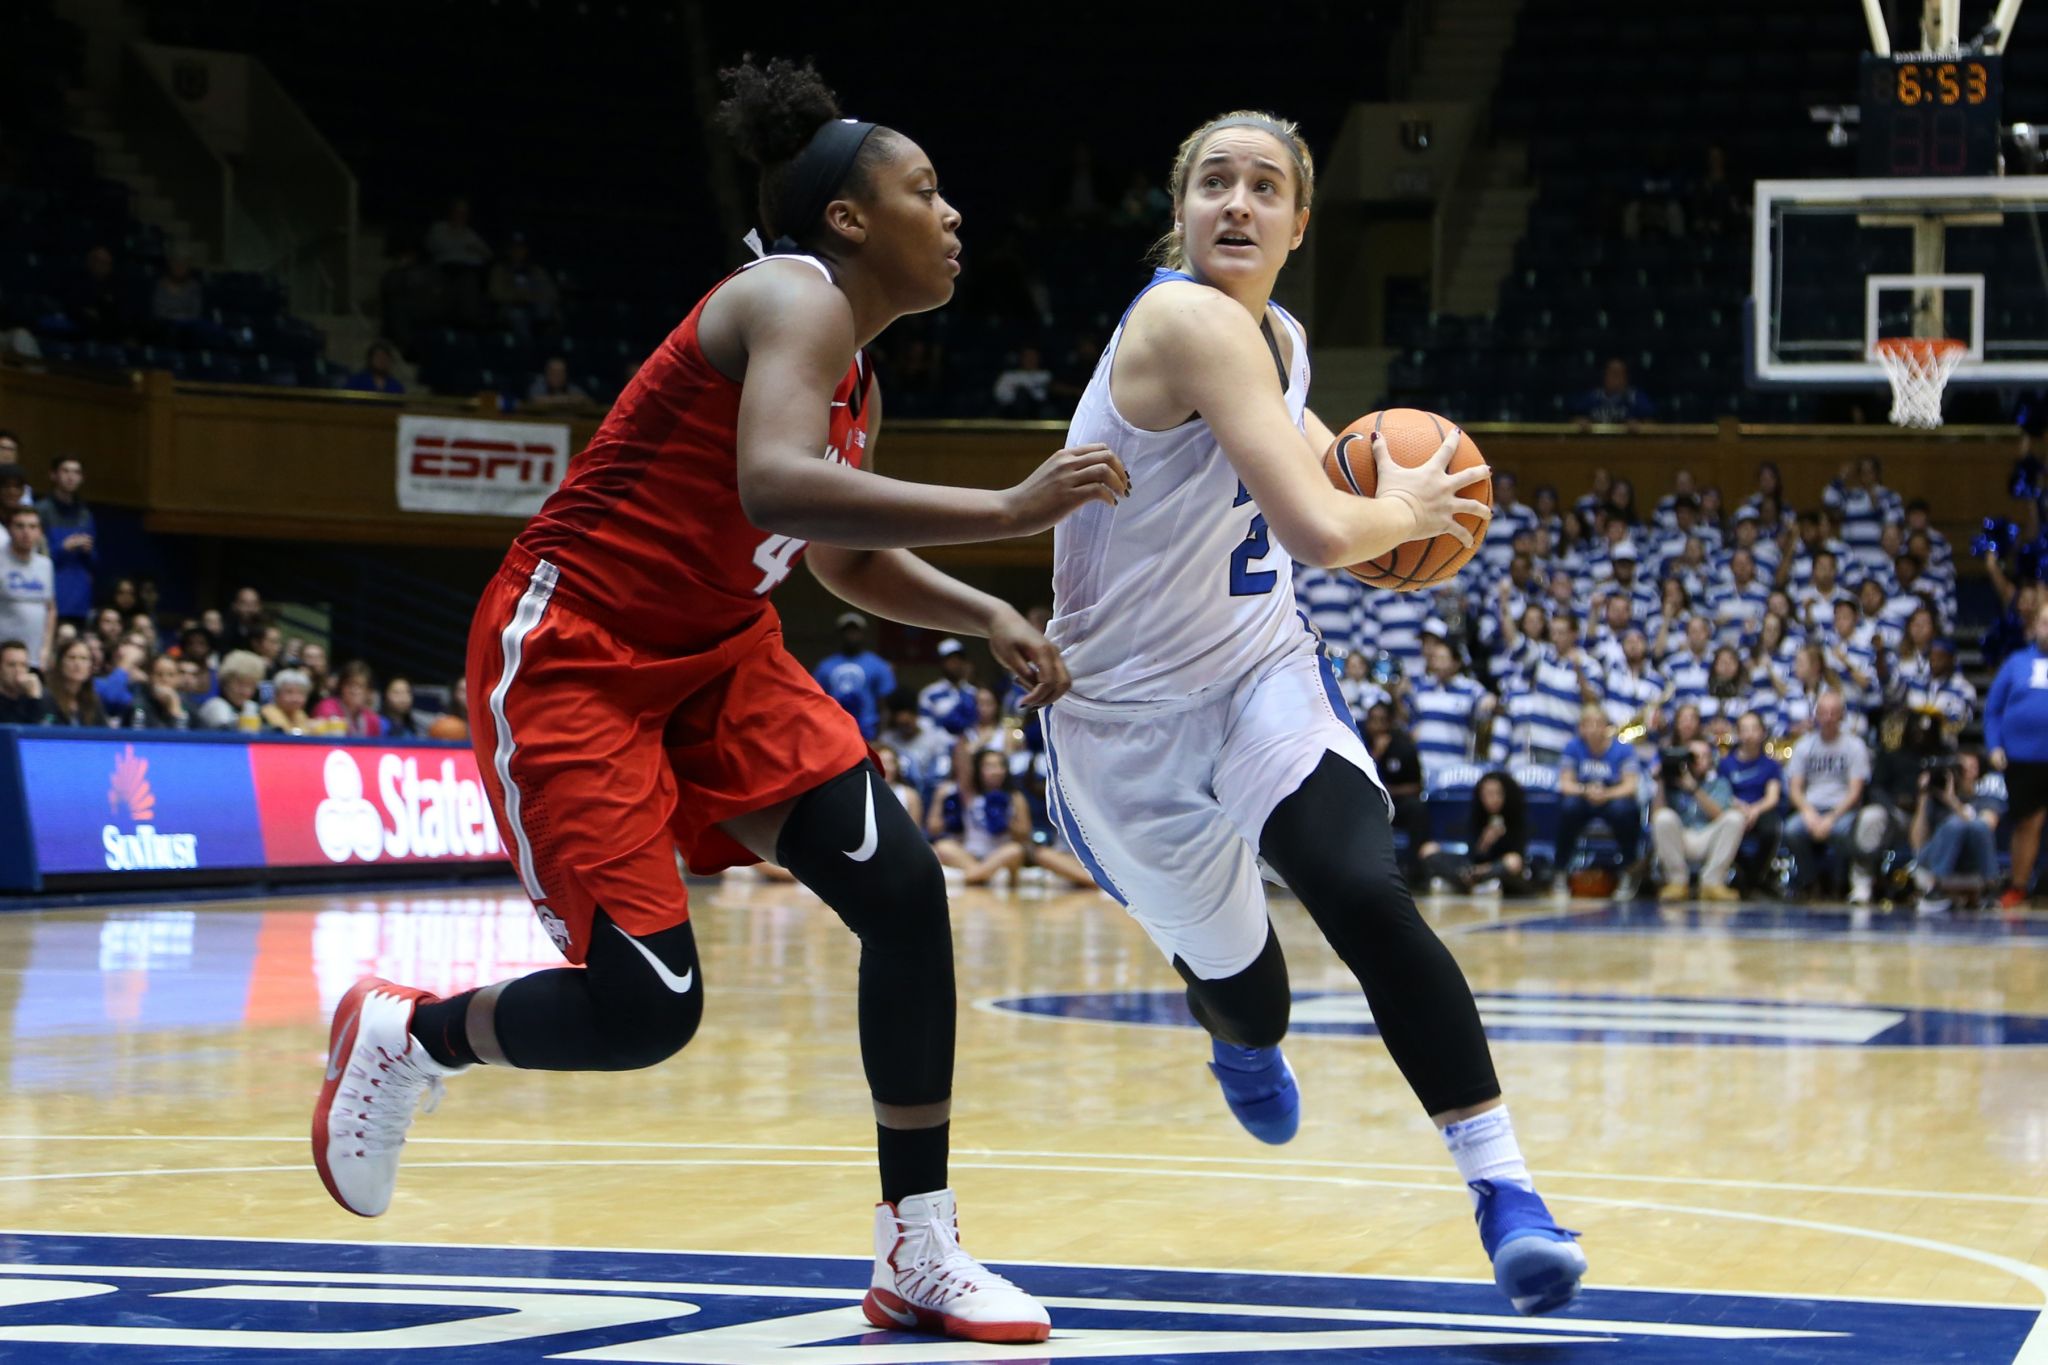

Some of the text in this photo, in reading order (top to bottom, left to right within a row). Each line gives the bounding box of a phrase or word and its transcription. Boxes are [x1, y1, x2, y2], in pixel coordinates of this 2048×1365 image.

[1897, 63, 1987, 106] 6:53
[411, 436, 556, 483] ESPN
[752, 534, 809, 596] 4
[1230, 512, 1278, 596] 2
